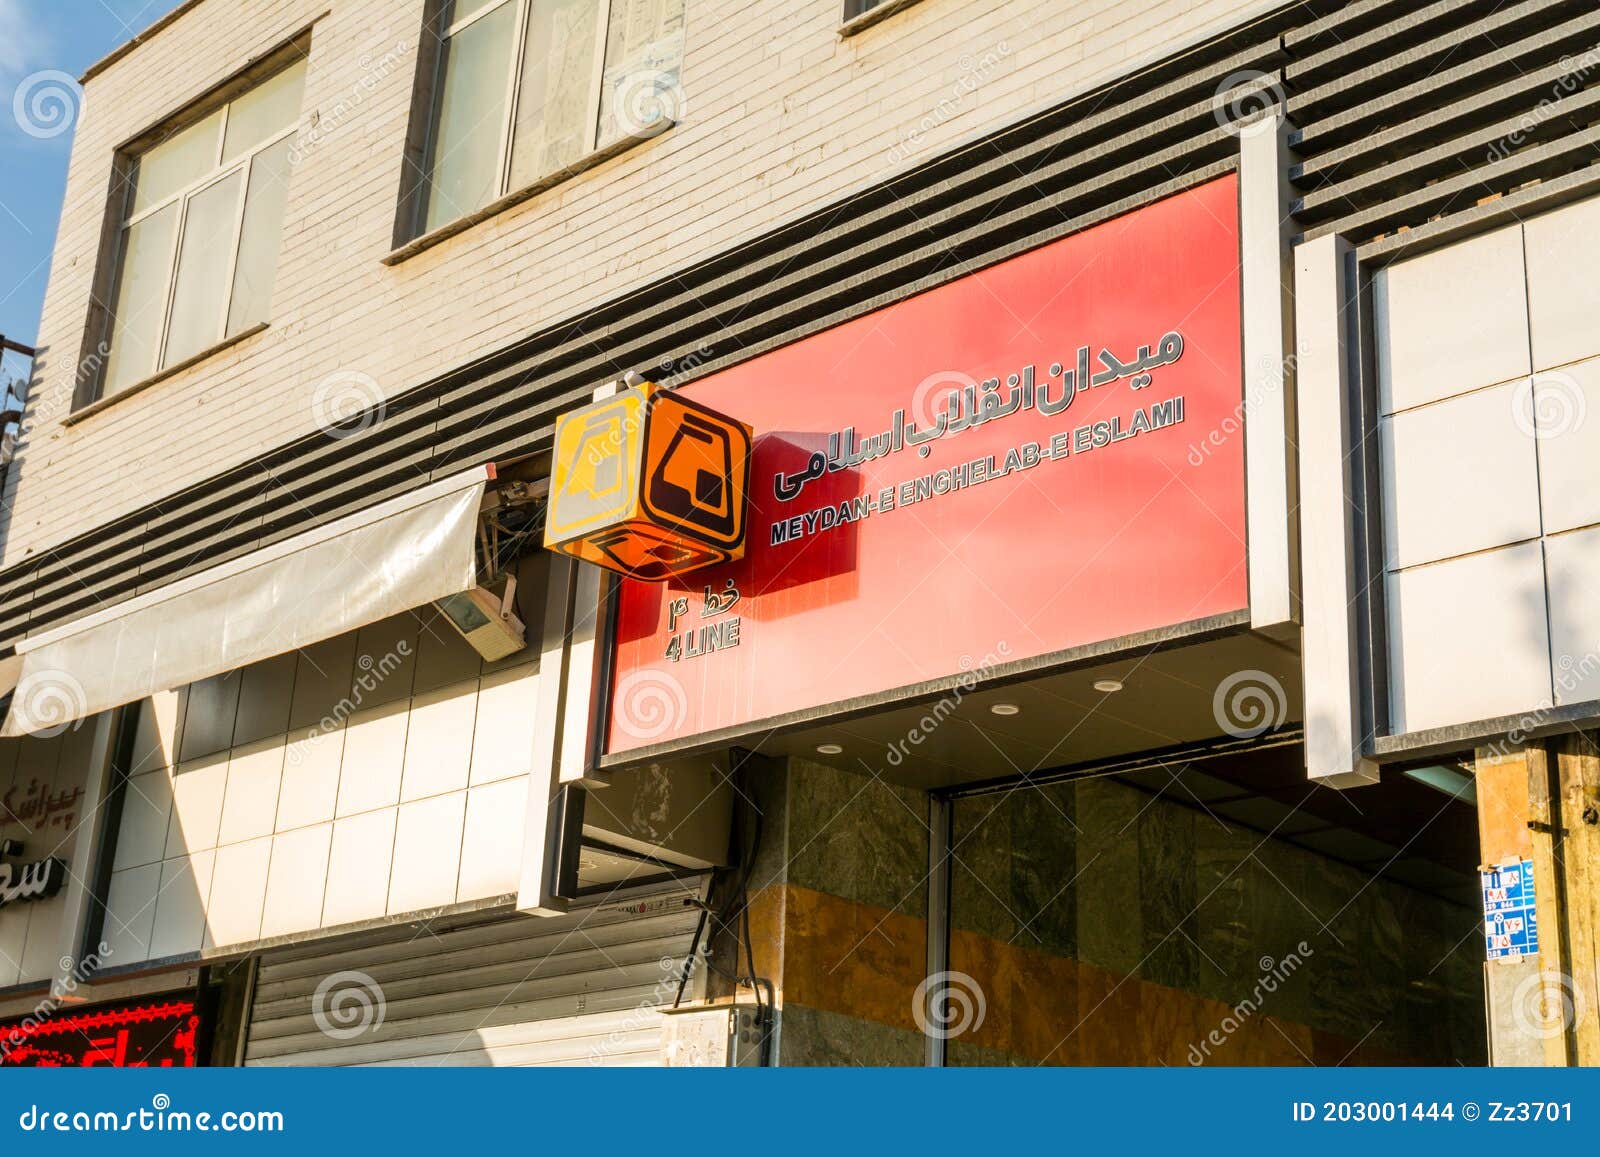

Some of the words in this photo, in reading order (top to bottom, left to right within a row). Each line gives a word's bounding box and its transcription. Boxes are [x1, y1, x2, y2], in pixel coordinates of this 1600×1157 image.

[905, 365, 1036, 457] انقلاب
[1036, 331, 1185, 416] میدان
[770, 486, 896, 546] MEYDAN-E
[898, 432, 1069, 507] ENGHELAB-E
[1073, 396, 1185, 454] ESLAMI
[773, 408, 904, 501] اسلامی
[664, 634, 682, 662] 4
[684, 617, 741, 659] LINE
[700, 578, 740, 619] خط
